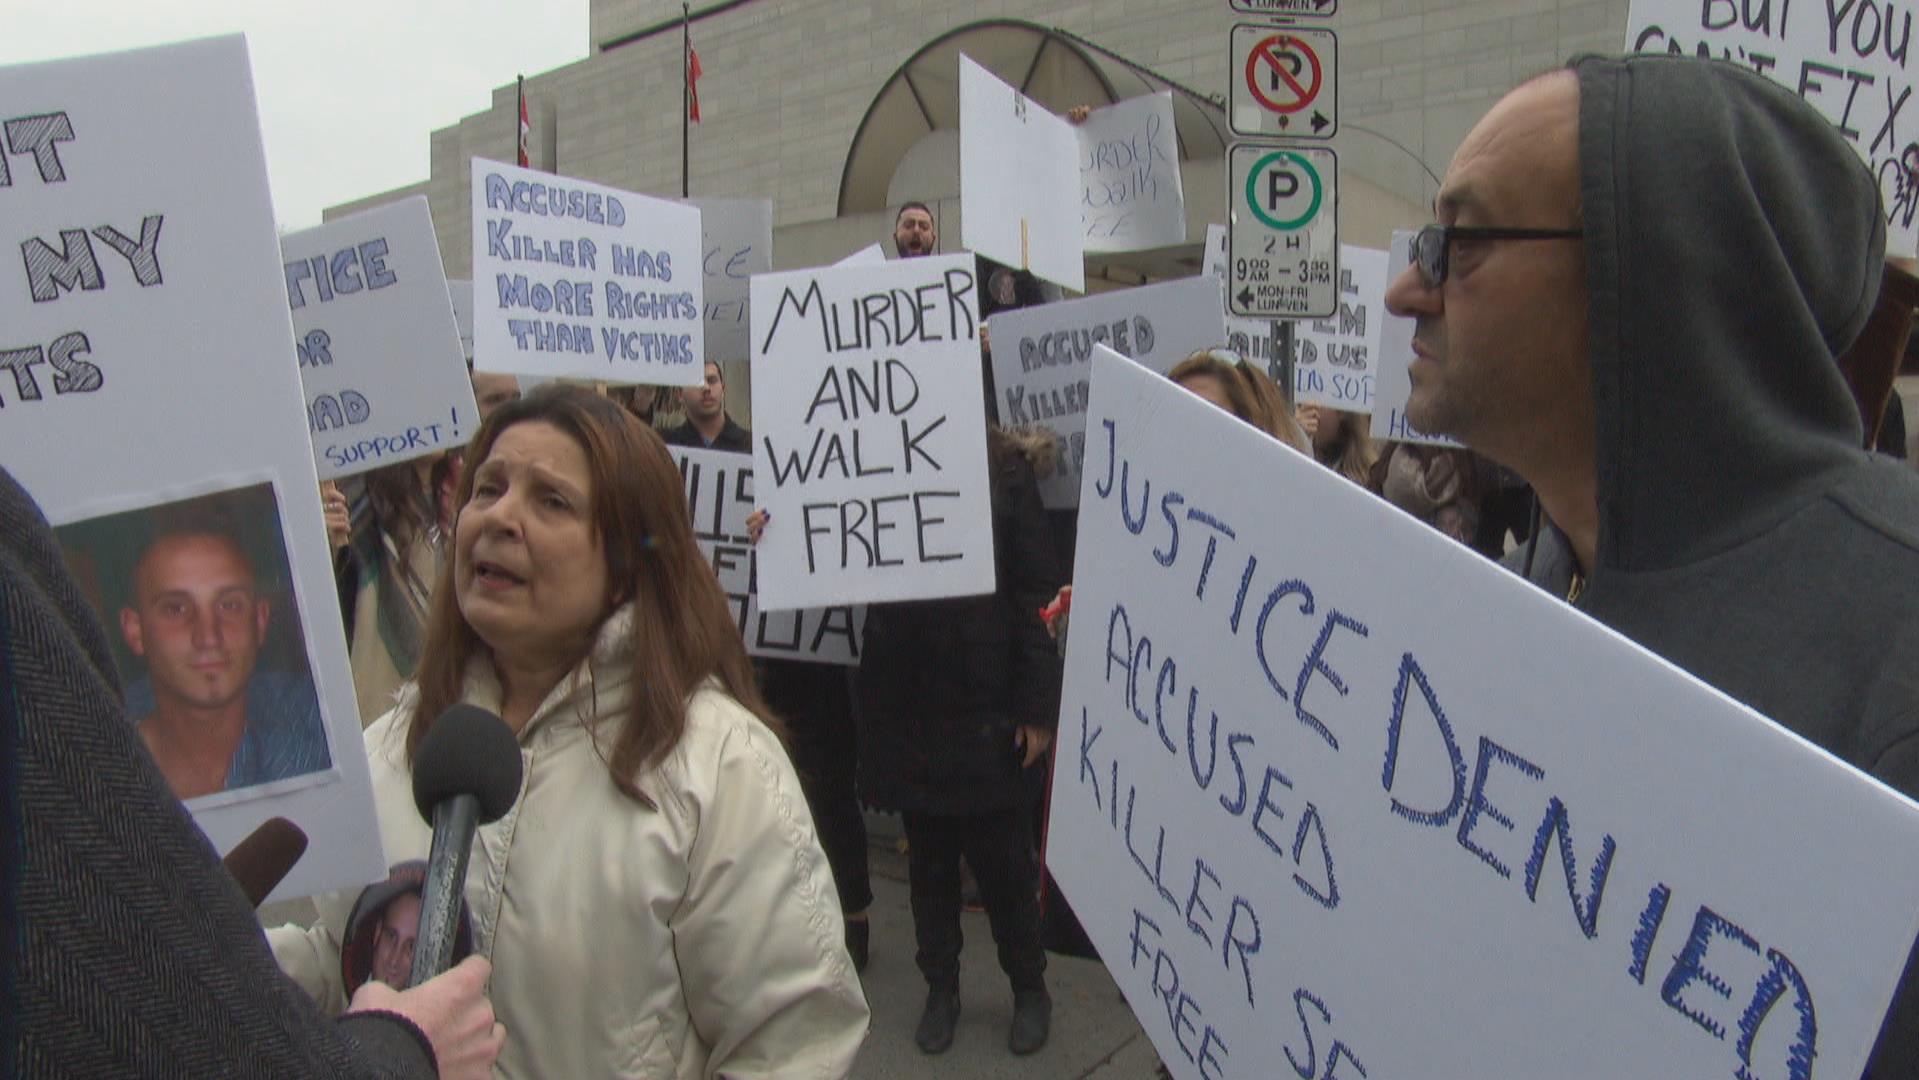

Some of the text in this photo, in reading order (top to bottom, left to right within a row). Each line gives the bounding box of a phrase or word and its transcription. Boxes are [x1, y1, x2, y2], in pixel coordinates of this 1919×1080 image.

[1826, 0, 1912, 70] YOU
[485, 173, 626, 228] ACCUSED
[20, 215, 164, 303] MY
[283, 236, 398, 311] TICE
[487, 218, 672, 283] KILLER HAS
[496, 273, 593, 318] MORE
[605, 280, 697, 321] RIGHTS
[762, 269, 974, 355] MURDER
[508, 319, 693, 367] THAN VICTIMS
[305, 389, 370, 432] AD
[805, 359, 920, 425] AND
[763, 416, 947, 488] WALK
[802, 491, 964, 574] FREE
[1095, 418, 1818, 1080] JUSTICE DENIED
[1106, 604, 1341, 910] ACCUSED
[1079, 706, 1262, 1010] KILLER
[1129, 907, 1229, 1080] FREE
